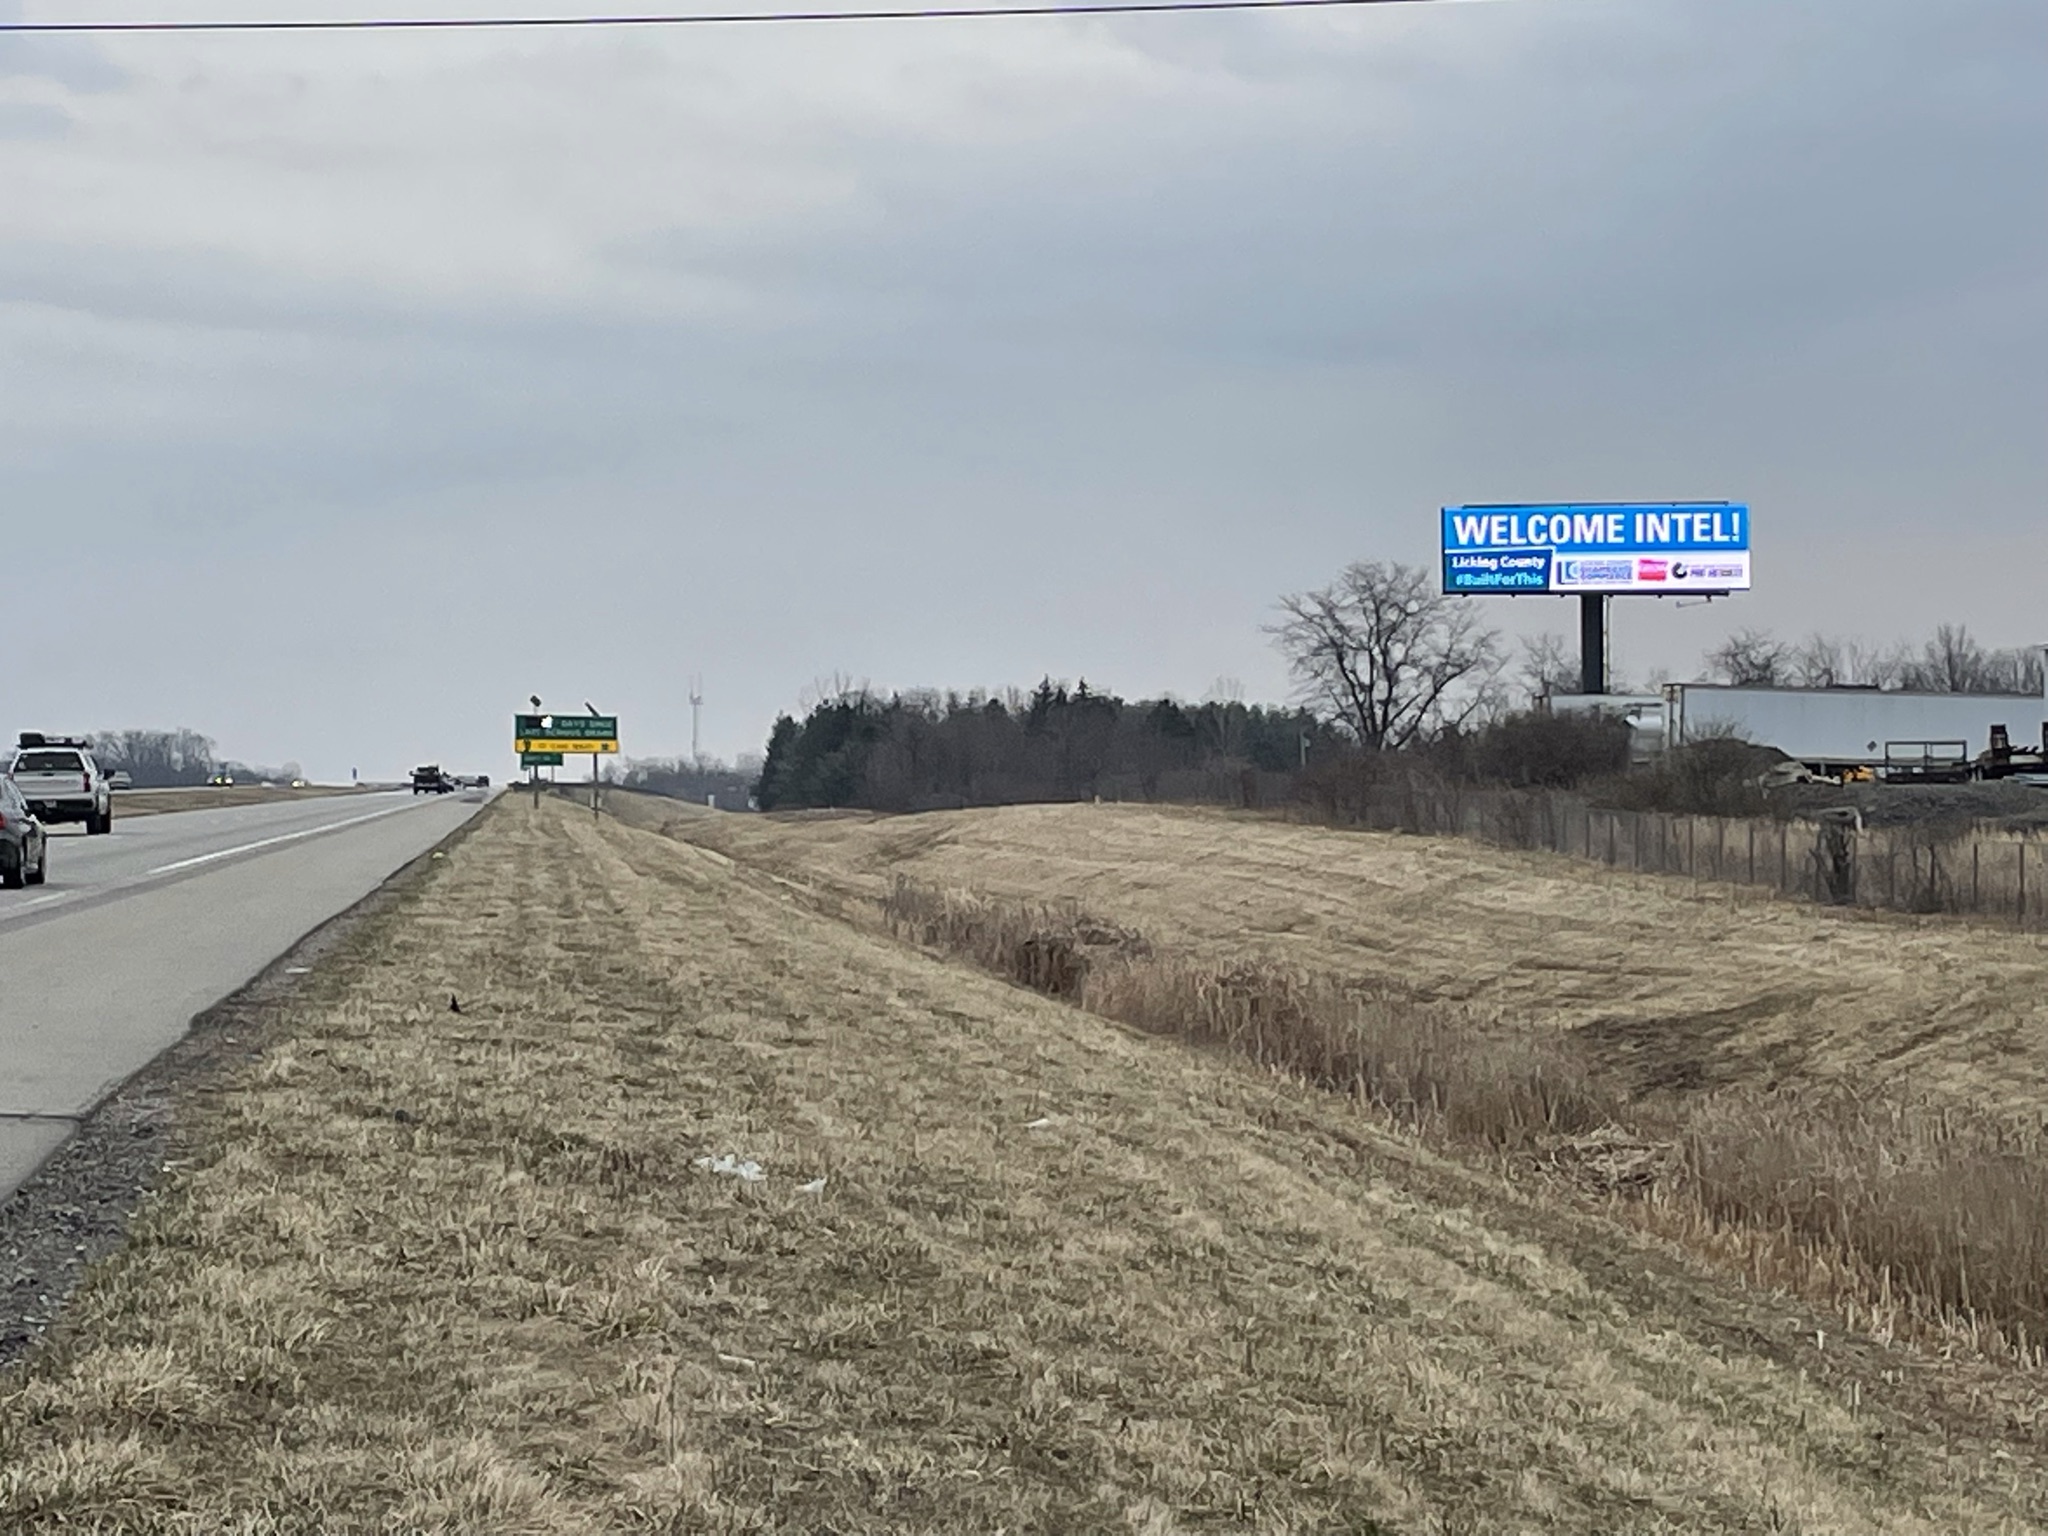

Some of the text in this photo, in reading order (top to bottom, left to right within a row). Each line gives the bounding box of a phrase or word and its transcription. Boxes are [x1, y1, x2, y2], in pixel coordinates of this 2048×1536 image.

[1453, 513, 1740, 545] WELCOME INTEL!
[1452, 555, 1546, 571] Licking County
[1456, 572, 1544, 585] #BuiltForThis
